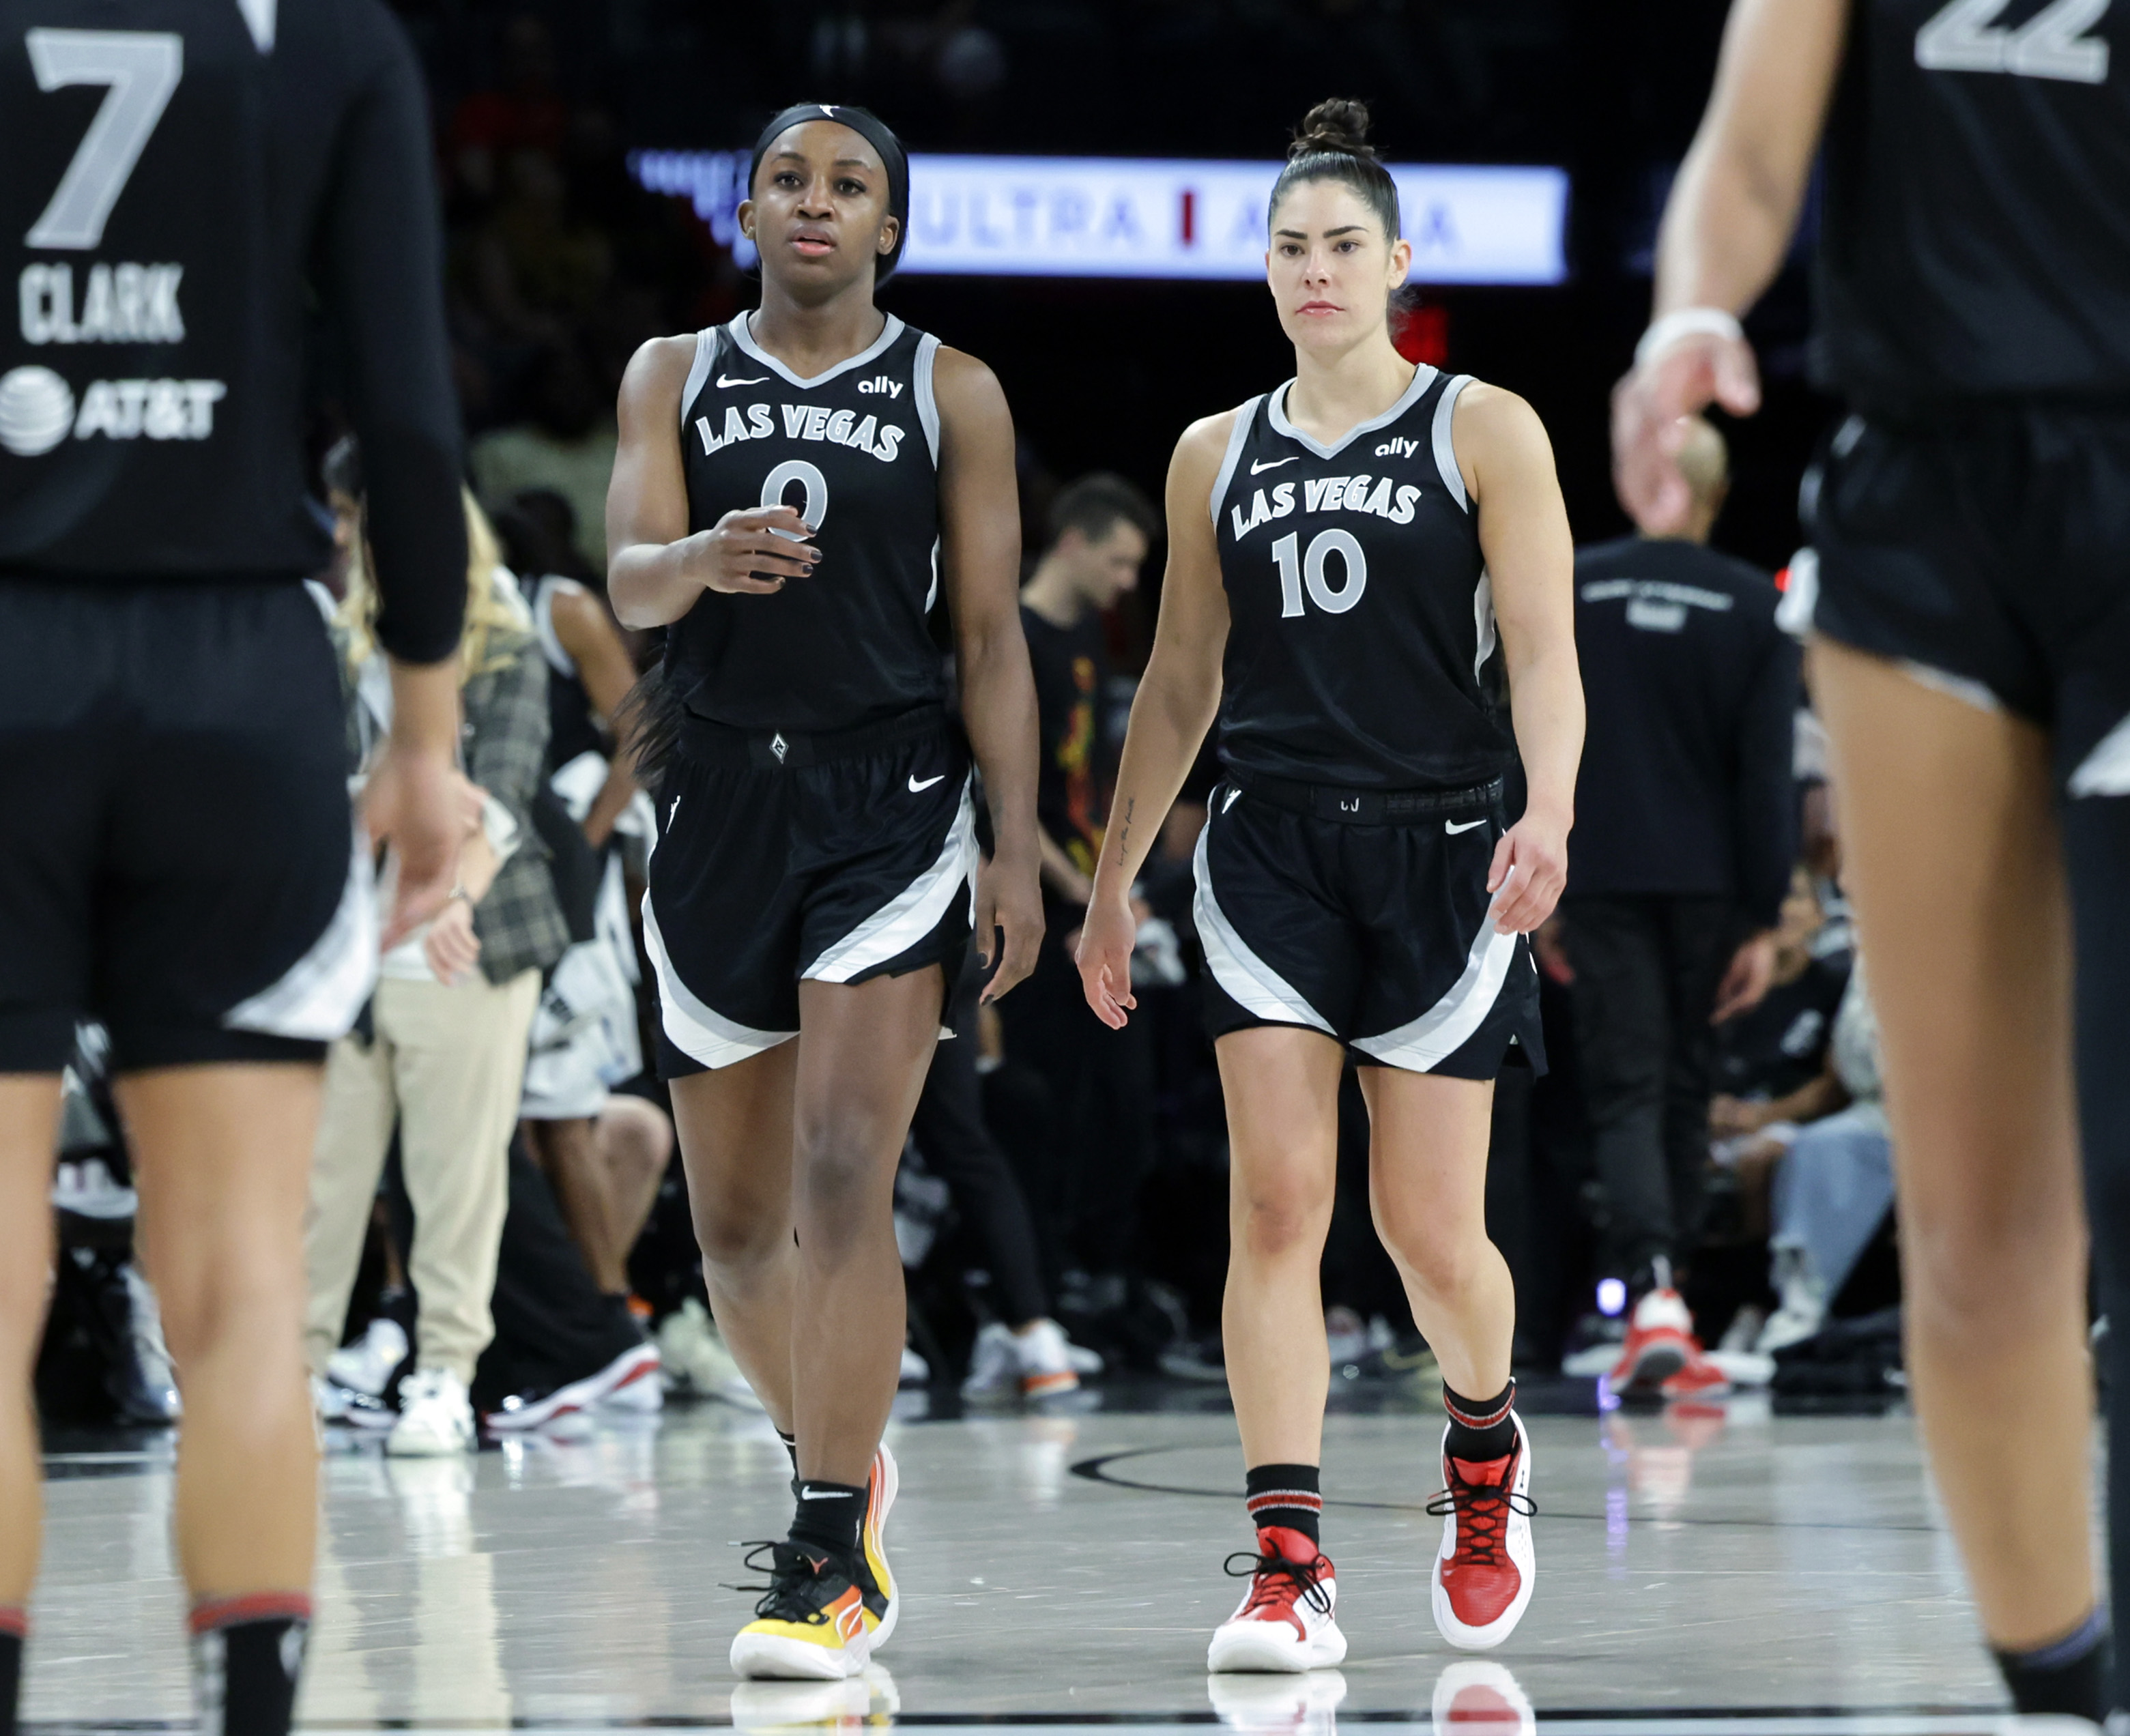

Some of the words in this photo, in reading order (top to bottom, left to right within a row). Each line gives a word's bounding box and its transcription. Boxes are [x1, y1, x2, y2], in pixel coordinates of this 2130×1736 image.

[25, 26, 184, 250] 7
[912, 186, 1142, 249] ULTRA
[18, 262, 186, 345] CLARK
[74, 379, 227, 440] AT&T
[857, 376, 904, 399] ally
[695, 403, 775, 456] LAS
[781, 404, 906, 463] VEGAS
[1375, 437, 1420, 459] ally
[760, 459, 829, 543] 0
[1230, 482, 1296, 542] LAS
[1304, 474, 1422, 525] VEGAS
[1271, 528, 1368, 618] 10
